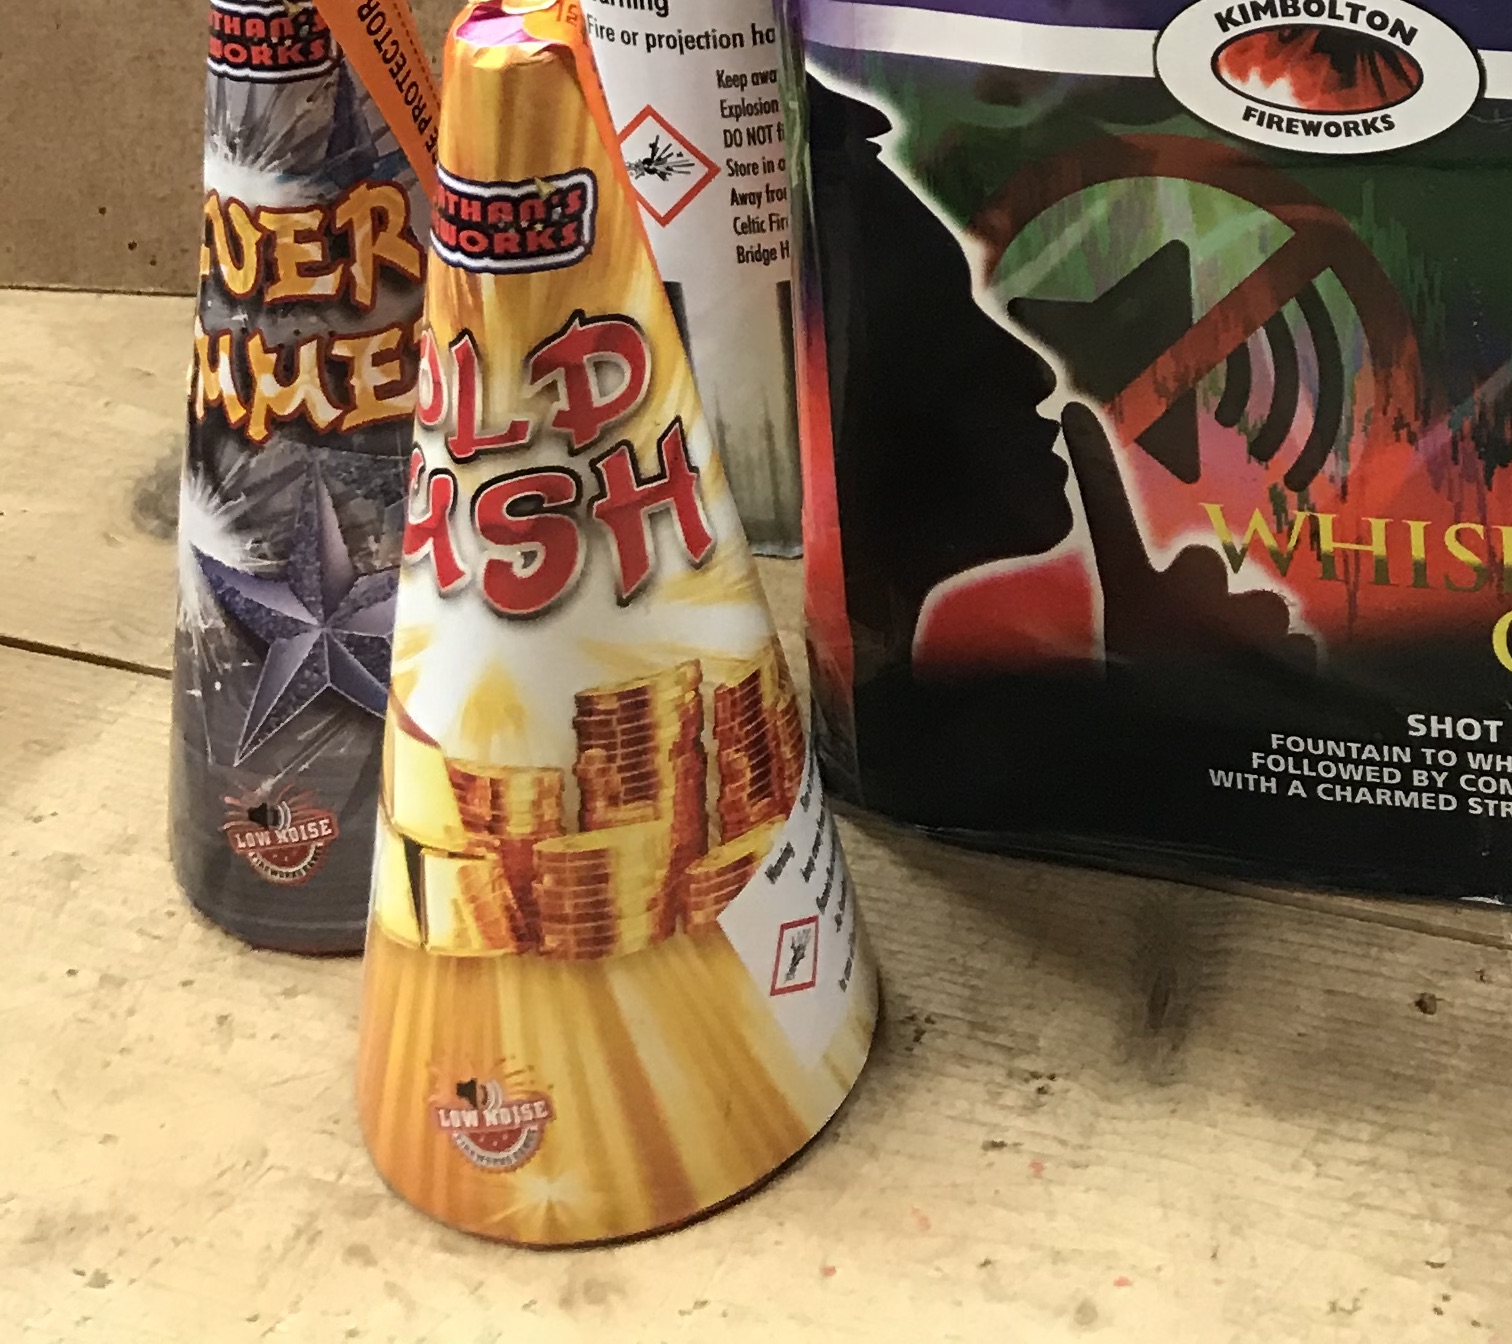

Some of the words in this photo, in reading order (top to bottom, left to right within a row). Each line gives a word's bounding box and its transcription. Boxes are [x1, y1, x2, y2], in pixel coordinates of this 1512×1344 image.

[586, 12, 616, 43] Fire
[621, 29, 639, 46] or
[645, 27, 746, 56] projection
[715, 68, 748, 92] Keep
[720, 97, 780, 123] Explosion
[1241, 104, 1397, 139] FIREWORKS
[723, 128, 744, 149] DO
[746, 126, 775, 147] NOT
[725, 158, 760, 180] Store
[729, 187, 764, 210] Away
[732, 215, 767, 237] Celtic
[735, 242, 779, 266] Bridge
[1407, 712, 1505, 744] SHOT
[1270, 732, 1413, 763] FOUNTAIN
[1421, 747, 1458, 767] TO
[1251, 751, 1403, 785] FOLLOWED
[1411, 769, 1449, 789] BY
[1208, 767, 1278, 795] WITH
[1286, 779, 1308, 798] A
[1316, 782, 1459, 812] CHARMED
[235, 829, 273, 849] LOW
